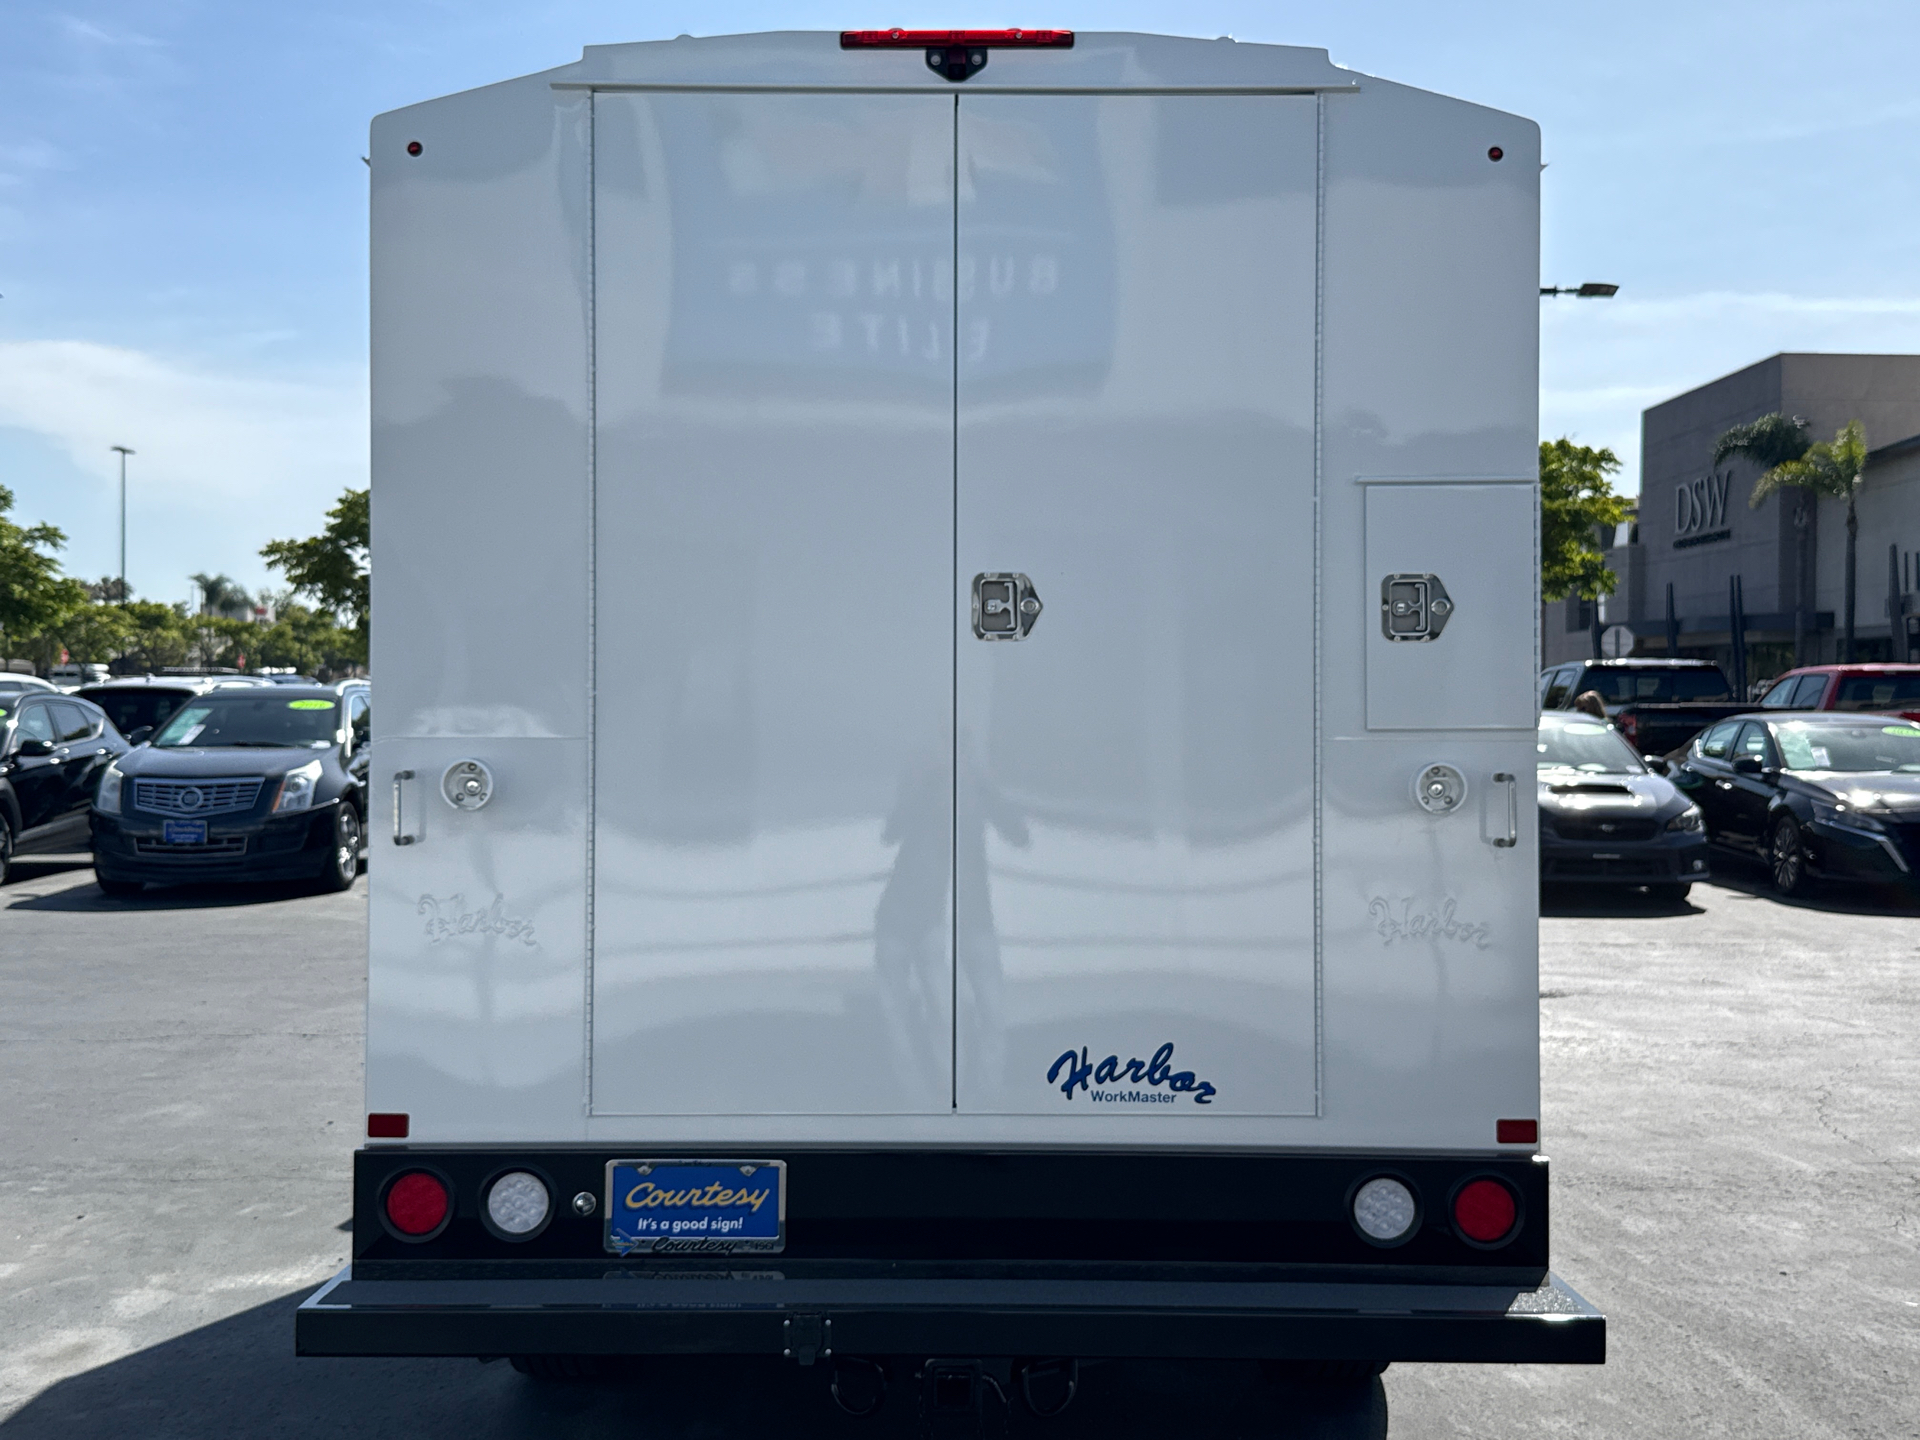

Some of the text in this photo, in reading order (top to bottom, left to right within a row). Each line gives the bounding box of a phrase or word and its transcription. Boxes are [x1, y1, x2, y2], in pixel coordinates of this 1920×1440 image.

[1675, 470, 1731, 535] DSW
[1047, 1042, 1216, 1104] Harbor
[1091, 1090, 1177, 1103] WorkMaster
[625, 1181, 770, 1212] Courtesy
[637, 1216, 743, 1234] It's a good sign!
[652, 1236, 735, 1254] Courtesy
